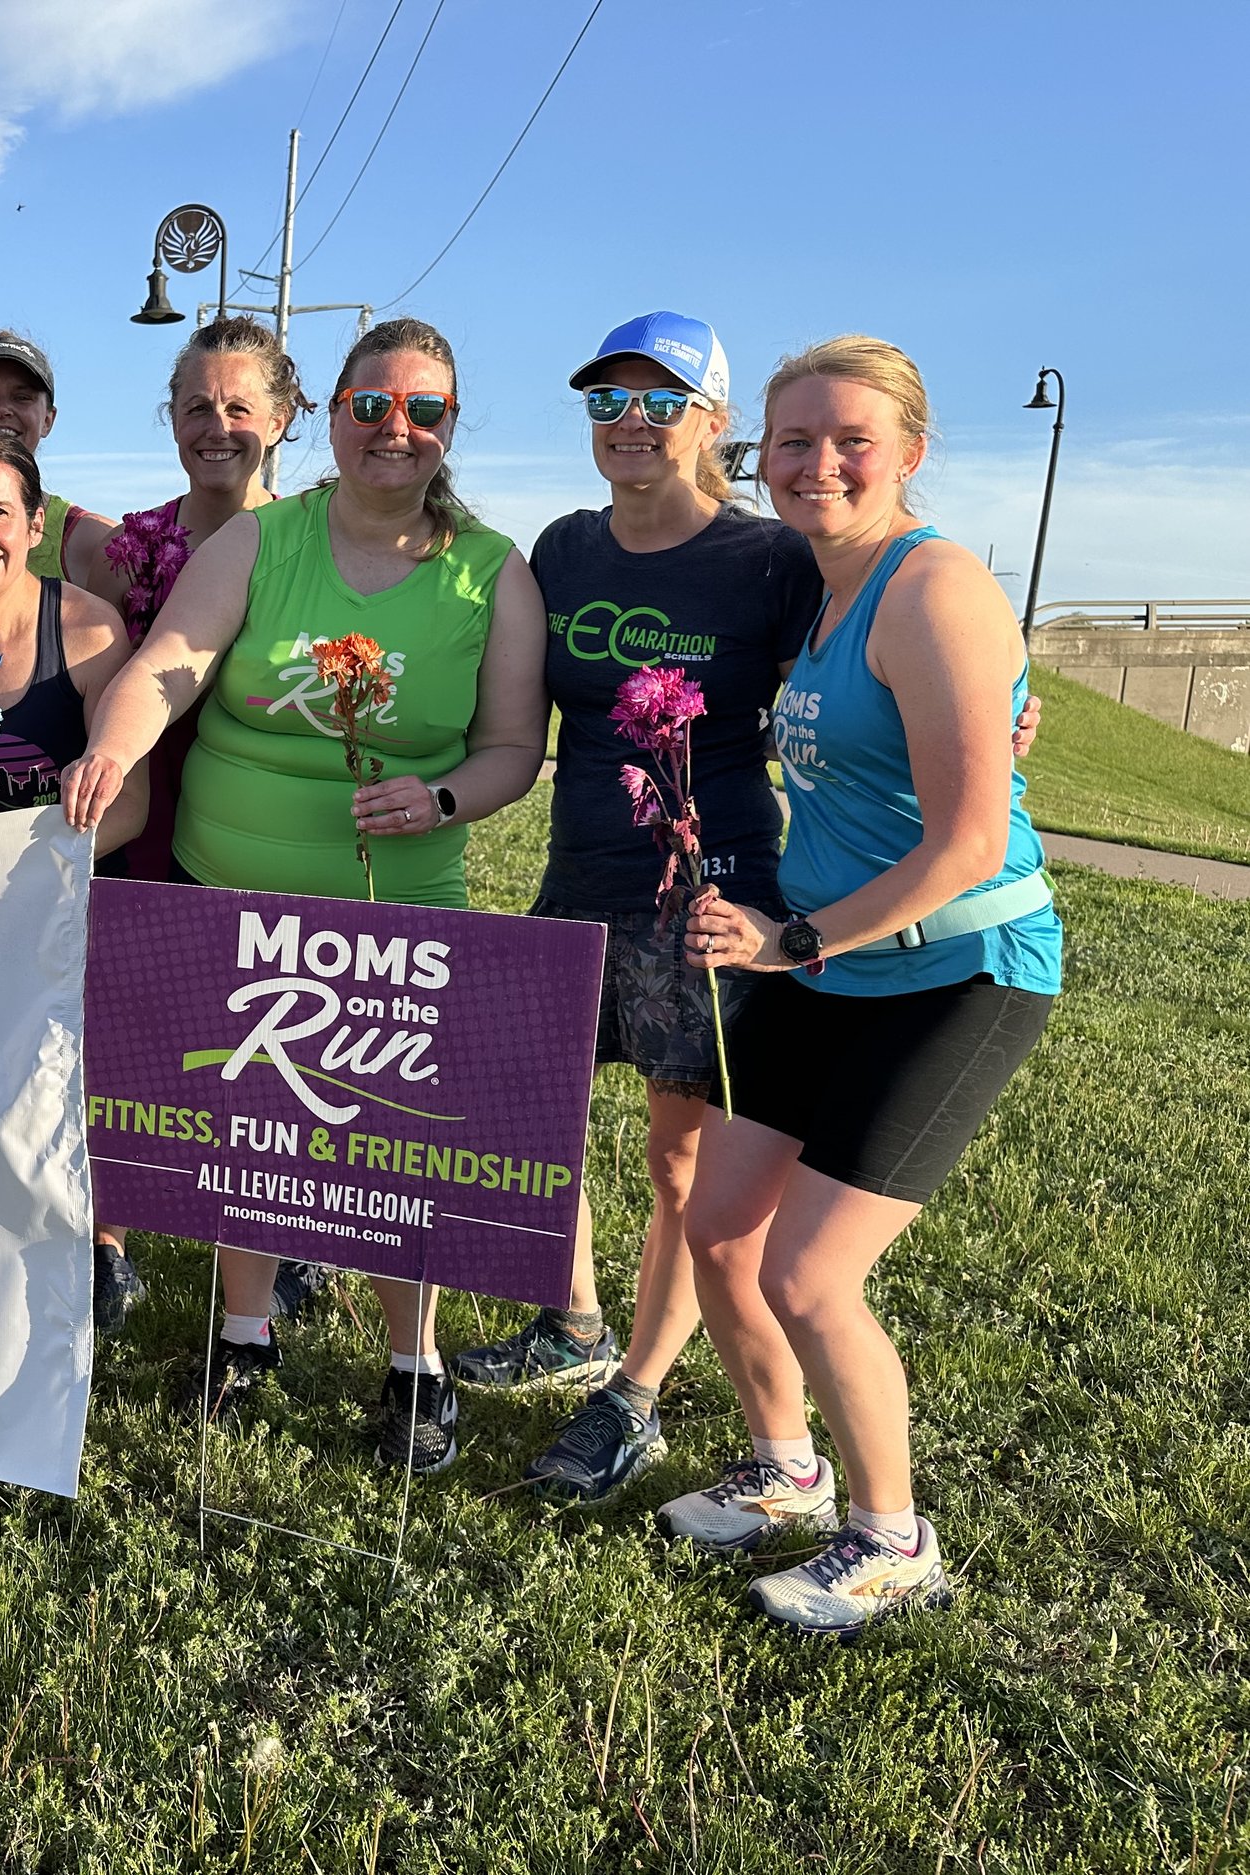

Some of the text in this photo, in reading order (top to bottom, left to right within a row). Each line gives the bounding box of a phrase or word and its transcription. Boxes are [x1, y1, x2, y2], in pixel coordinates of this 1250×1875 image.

[653, 344, 702, 370] RACE COMMITTEE
[288, 631, 406, 677] MS
[548, 600, 717, 668] THE EC MARATHON
[664, 652, 712, 662] SCHEELS
[266, 665, 398, 738] Rn
[773, 715, 826, 791] Run
[789, 724, 816, 740] on the
[32, 792, 58, 807] 2019
[701, 855, 736, 877] 13.1
[237, 911, 451, 990] MOMS
[347, 995, 440, 1026] on the
[221, 977, 440, 1125] Run
[87, 1096, 572, 1199] FITNESS, FUN & FRIENDSHIP
[196, 1162, 435, 1229] ALL LEVELS WELCOME
[223, 1204, 402, 1247] momsontherun.com
